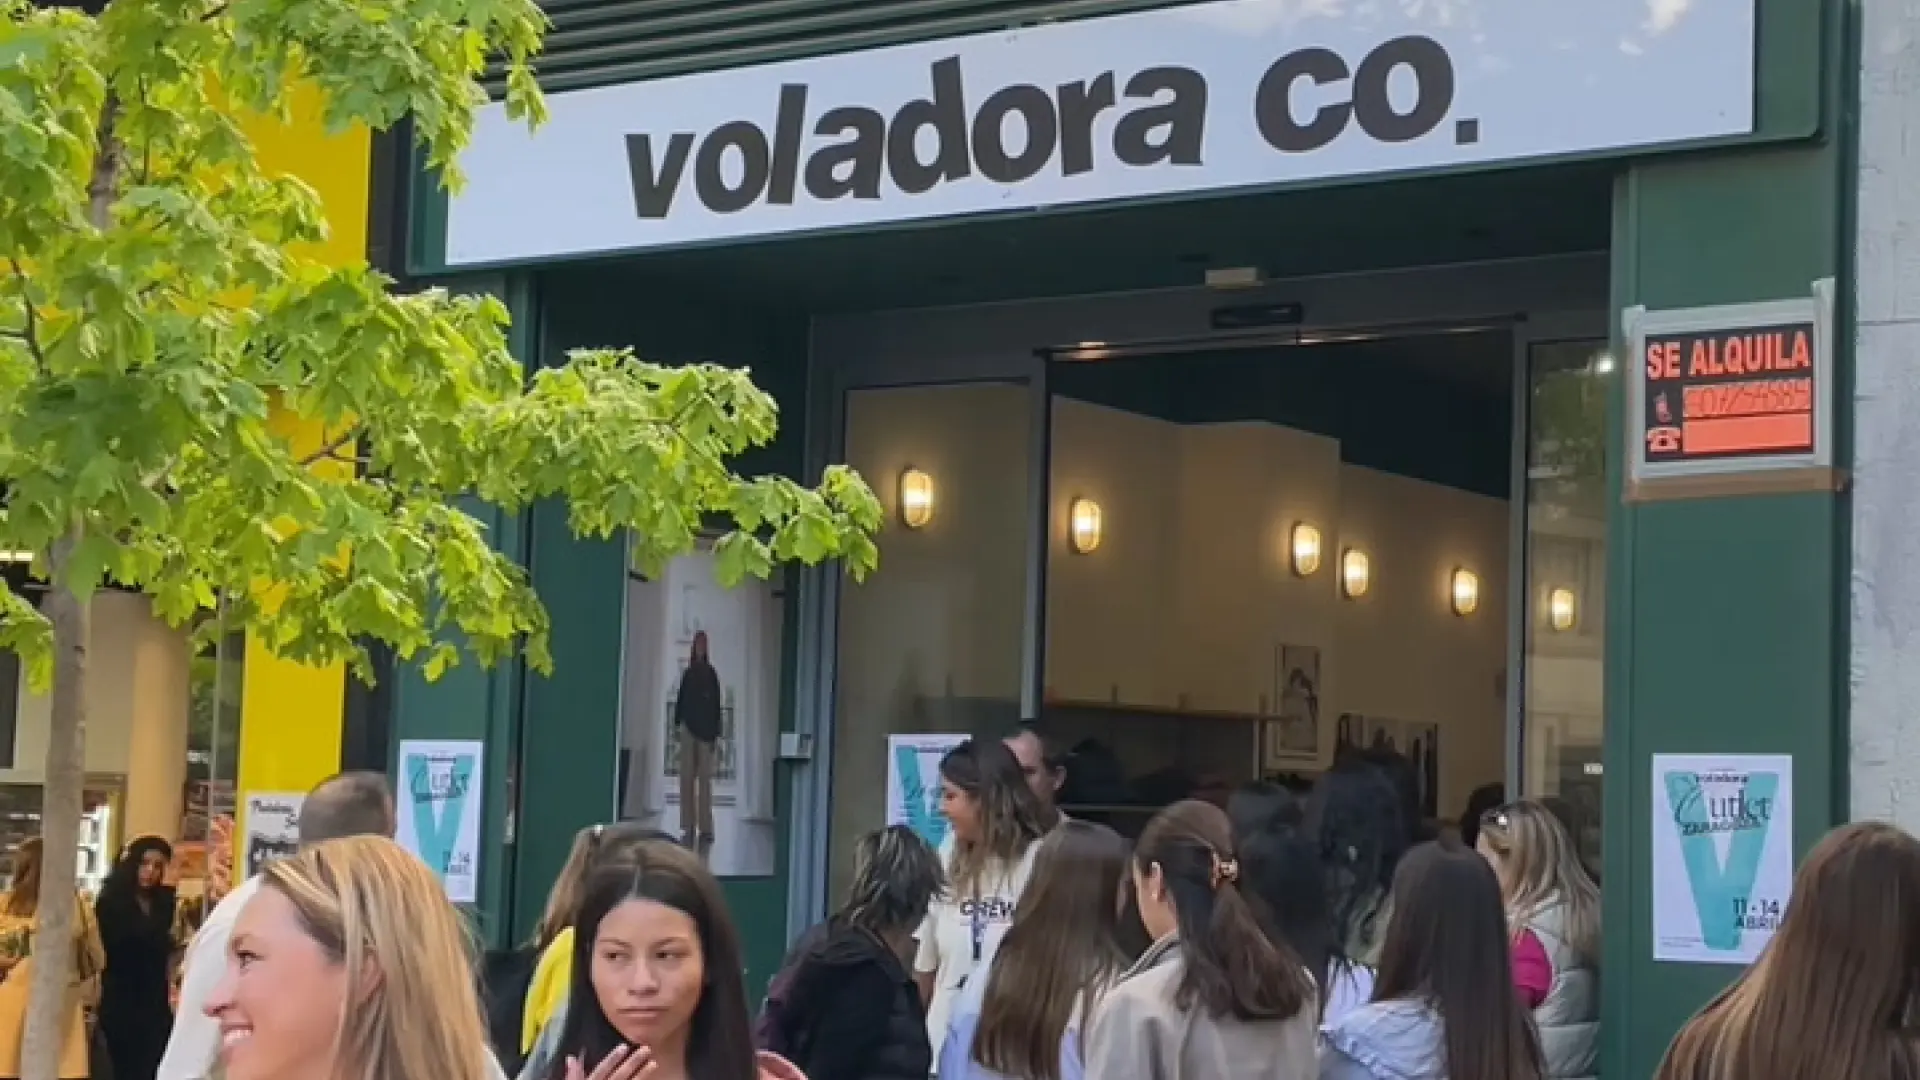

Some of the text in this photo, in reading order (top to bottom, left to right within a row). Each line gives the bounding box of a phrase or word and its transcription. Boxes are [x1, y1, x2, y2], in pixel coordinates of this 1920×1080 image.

[626, 35, 1479, 220] voladora co.
[1647, 330, 1811, 380] SE ALQUILA
[1734, 915, 1776, 930] ABRI
